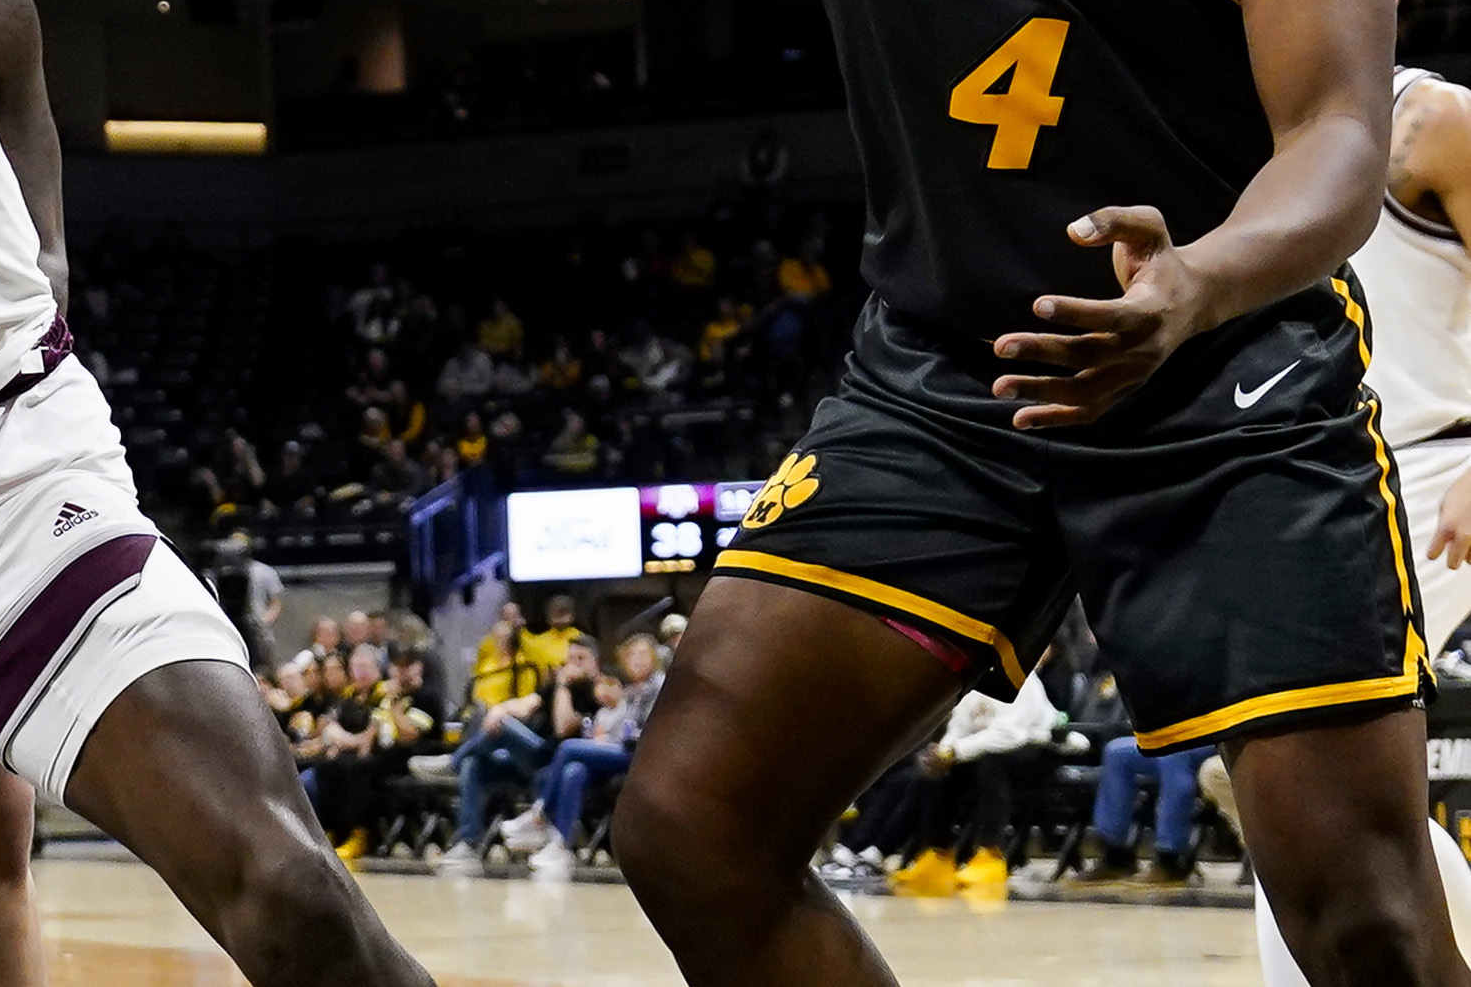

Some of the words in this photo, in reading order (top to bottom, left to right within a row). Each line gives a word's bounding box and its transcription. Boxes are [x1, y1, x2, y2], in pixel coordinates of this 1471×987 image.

[948, 17, 1070, 170] 4
[52, 509, 100, 538] adidas
[747, 500, 778, 523] M
